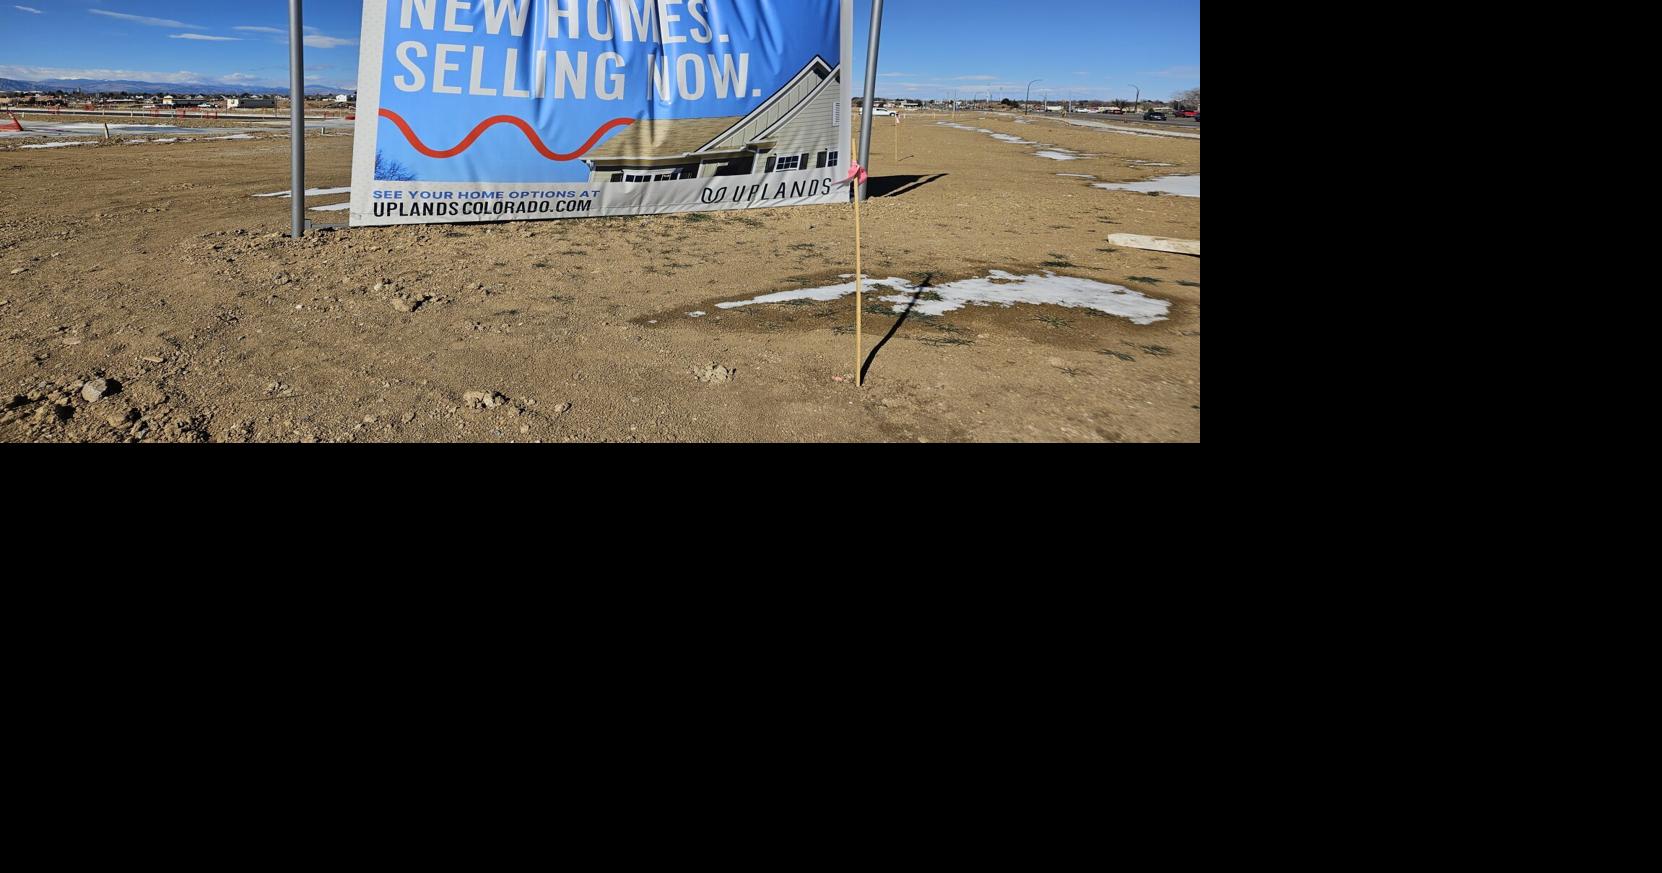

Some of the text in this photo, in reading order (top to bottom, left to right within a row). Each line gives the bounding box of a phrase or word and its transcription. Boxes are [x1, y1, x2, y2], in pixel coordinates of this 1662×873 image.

[400, 0, 729, 44] NEW HOMES.
[393, 40, 761, 101] SELLING NOW.
[372, 190, 601, 200] SEE YOUR HOME OPTIONS AT
[732, 177, 832, 203] UPLANDS
